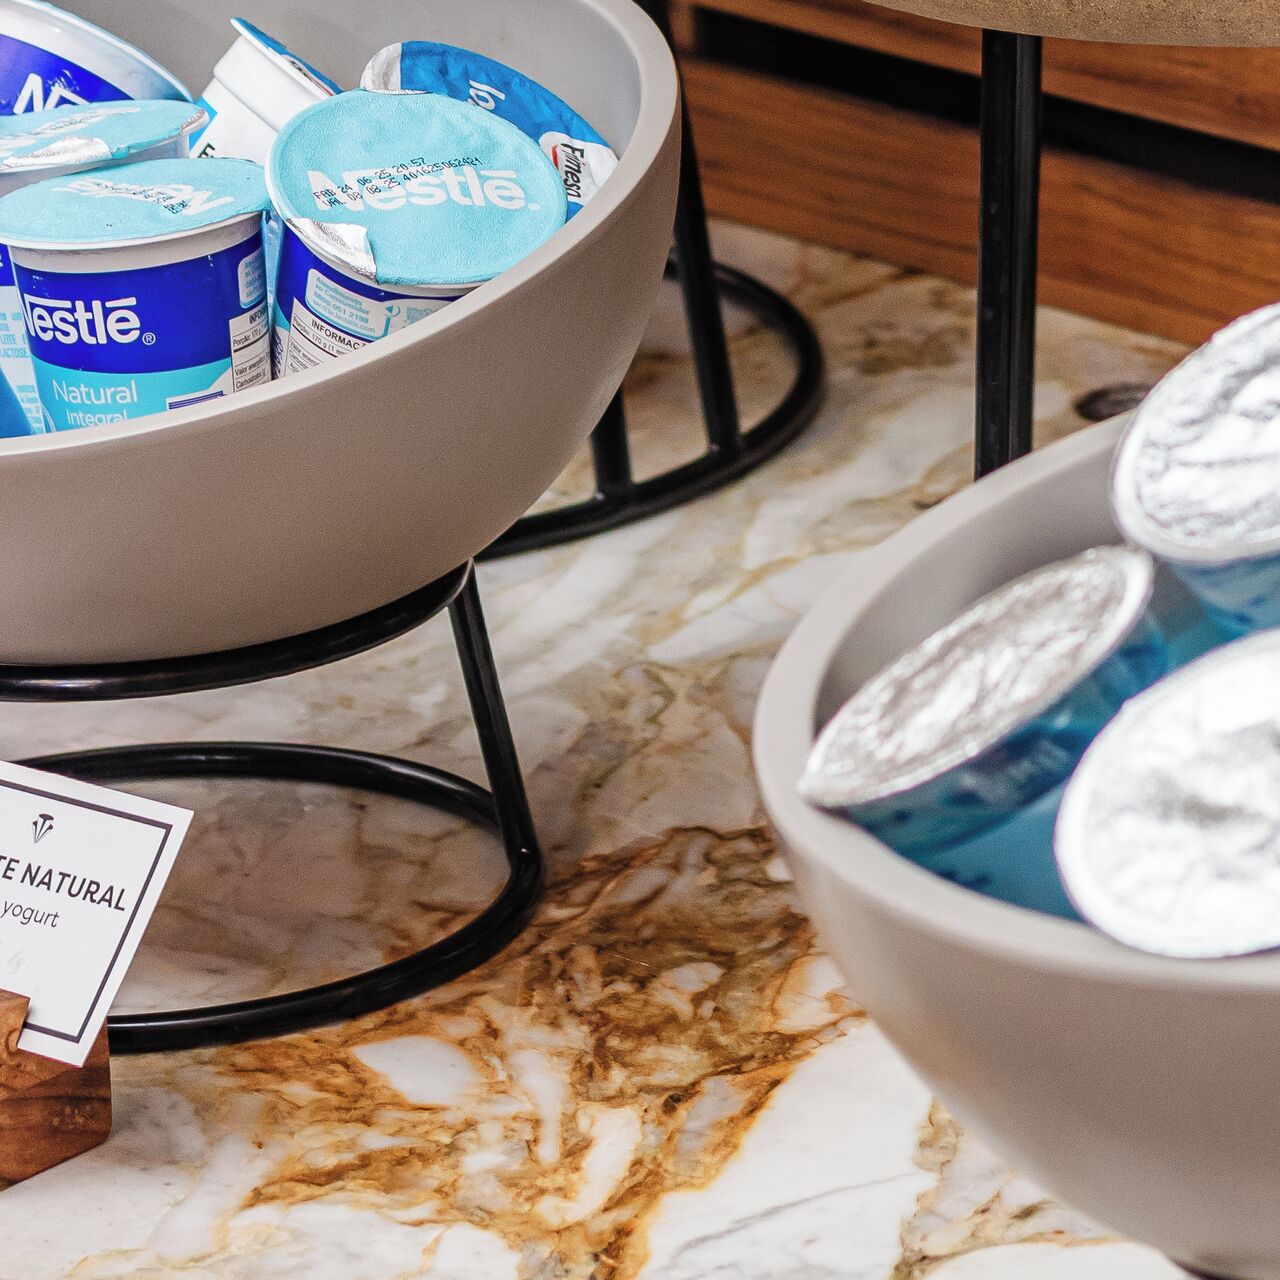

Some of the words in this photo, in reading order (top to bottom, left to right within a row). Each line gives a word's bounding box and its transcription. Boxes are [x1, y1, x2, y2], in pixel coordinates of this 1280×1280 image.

[313, 188, 337, 200] FAB
[338, 184, 353, 194] 24
[357, 175, 372, 186] 06
[375, 169, 392, 180] 25
[384, 177, 401, 190] 25
[52, 379, 138, 405] Natural
[20, 863, 126, 912] NATURAL
[0, 900, 60, 928] yogurt
